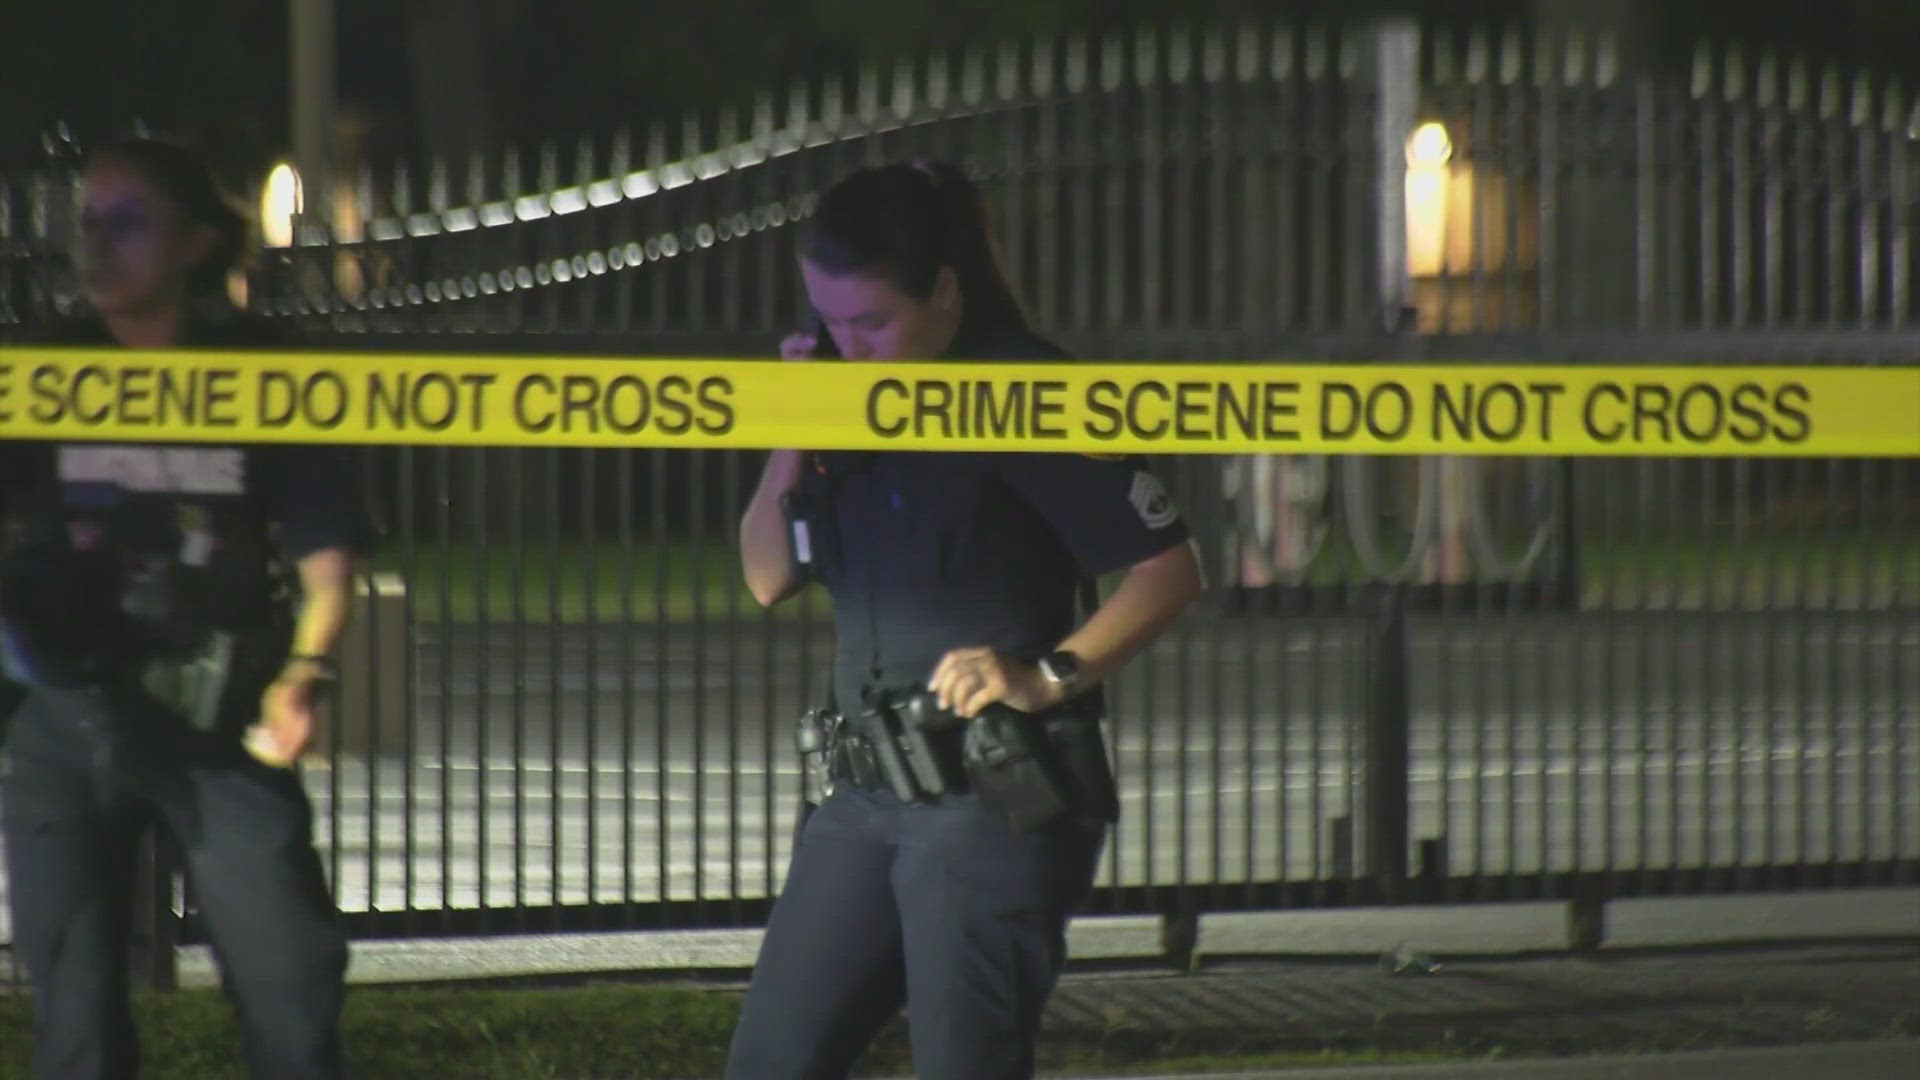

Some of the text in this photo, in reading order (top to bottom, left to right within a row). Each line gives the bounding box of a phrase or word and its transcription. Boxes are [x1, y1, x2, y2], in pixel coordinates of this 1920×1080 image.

[29, 365, 238, 427] SCENE
[258, 369, 349, 429] DO
[367, 372, 497, 431] NOT
[514, 373, 734, 436] CROSS
[866, 378, 1812, 445] CRIME SCENE DO NOT CROSS
